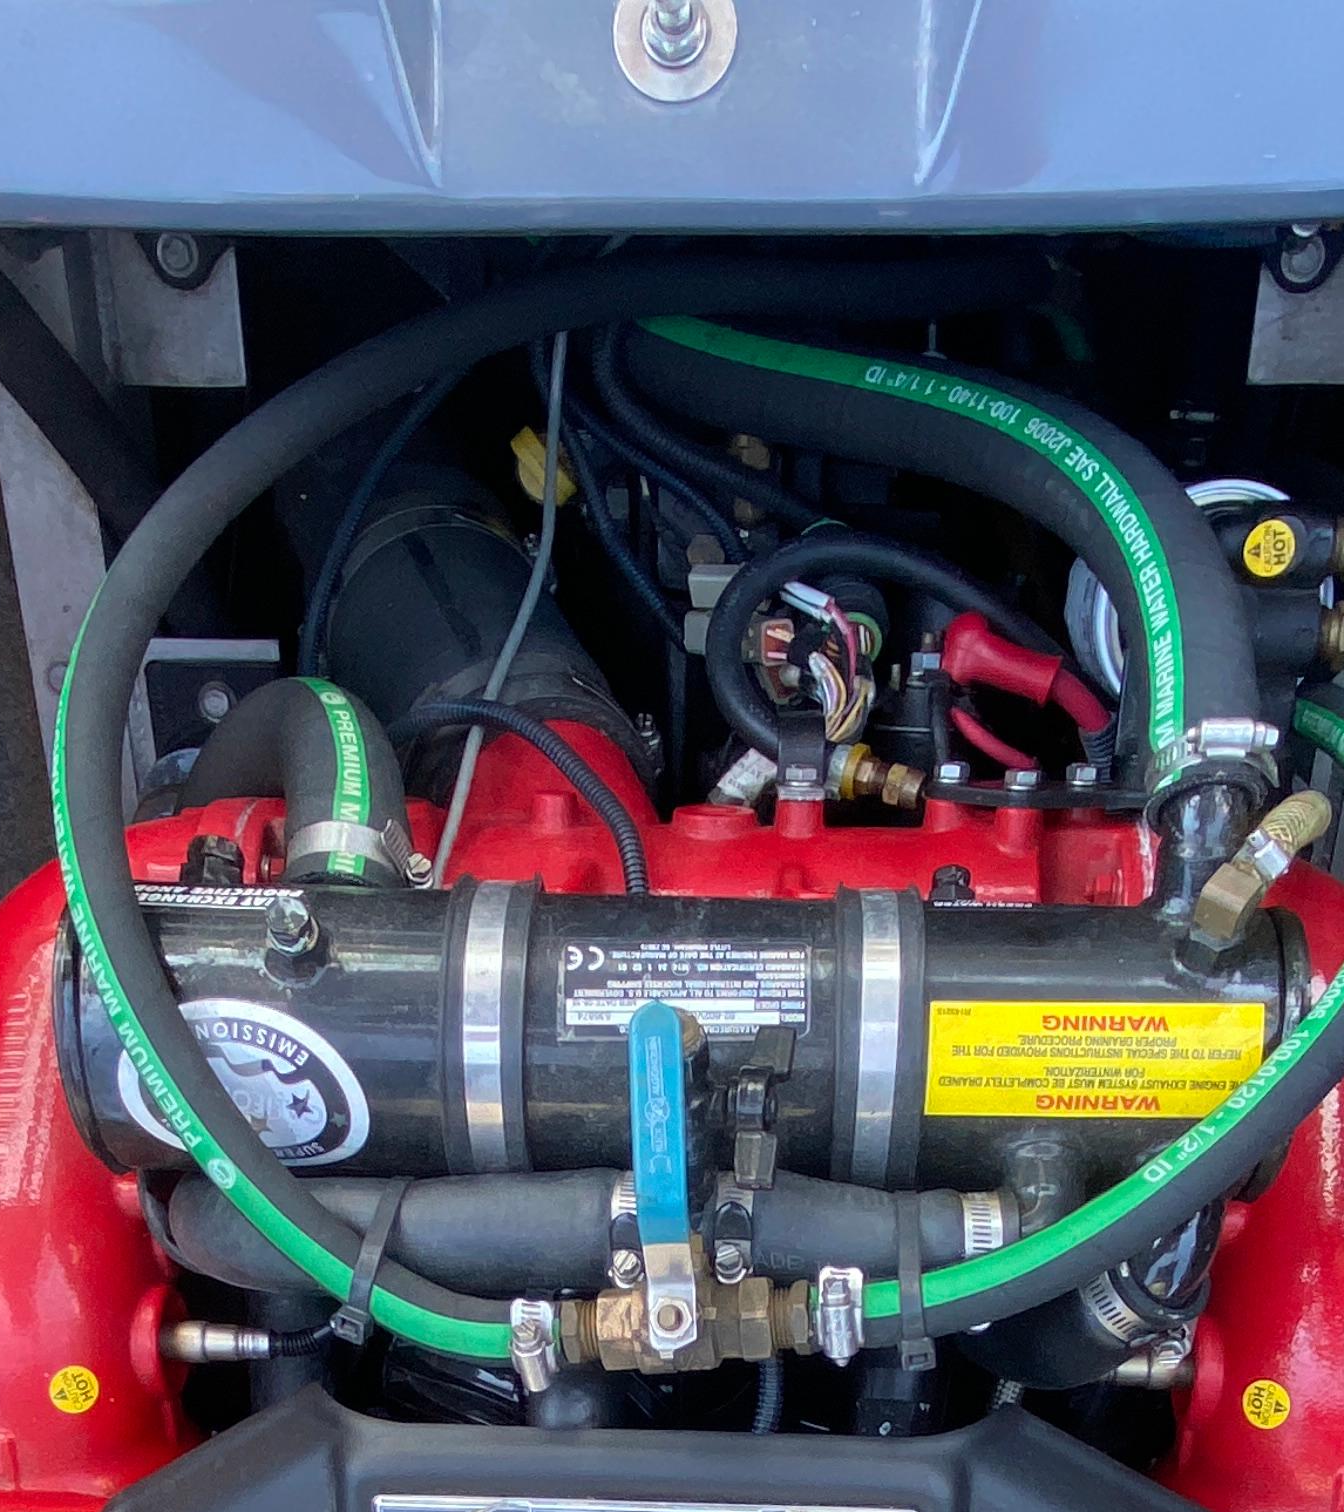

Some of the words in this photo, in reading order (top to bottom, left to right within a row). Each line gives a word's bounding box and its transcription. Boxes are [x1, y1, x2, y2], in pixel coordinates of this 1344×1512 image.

[865, 365, 885, 383] ID
[948, 386, 1021, 425] 100-1140
[1024, 417, 1072, 455] J2006
[1065, 446, 1099, 481] SAE
[1098, 472, 1154, 568] HARDWALL
[1273, 529, 1286, 566] HOT
[1139, 566, 1172, 636] WATER
[1153, 629, 1175, 725] MARINE
[333, 710, 361, 797] PREMIUM
[68, 899, 122, 1019] MARINE
[1042, 1015, 1169, 1032] WARNING
[195, 1022, 310, 1066] EMISSION
[1136, 1036, 1177, 1047] PROPER
[952, 1045, 971, 1056] THE
[973, 1046, 994, 1056] FOR
[997, 1046, 1047, 1057] PROVIDED
[1050, 1047, 1122, 1059] INSTRUCTIONS
[1127, 1048, 1167, 1059] SPECIAL
[1171, 1049, 1189, 1059] THE
[1192, 1049, 1205, 1059] TO
[1208, 1049, 1241, 1060] REFER
[1124, 1068, 1145, 1077] FOR
[1233, 1028, 1309, 1109] 100-0120
[118, 1020, 203, 1148] PREMIUM
[939, 1076, 983, 1087] DRAINED
[984, 1077, 1050, 1087] COMPLETELY
[1053, 1078, 1065, 1088] BE
[1068, 1079, 1095, 1089] MUST
[1099, 1079, 1138, 1089] SYSTEM
[1140, 1080, 1187, 1089] EXHAUST
[1190, 1080, 1226, 1090] ENGINE
[1036, 1096, 1160, 1111] WARNING
[1143, 1157, 1175, 1184] ID
[72, 1373, 94, 1402] HOT
[1249, 1386, 1267, 1419] HOT
